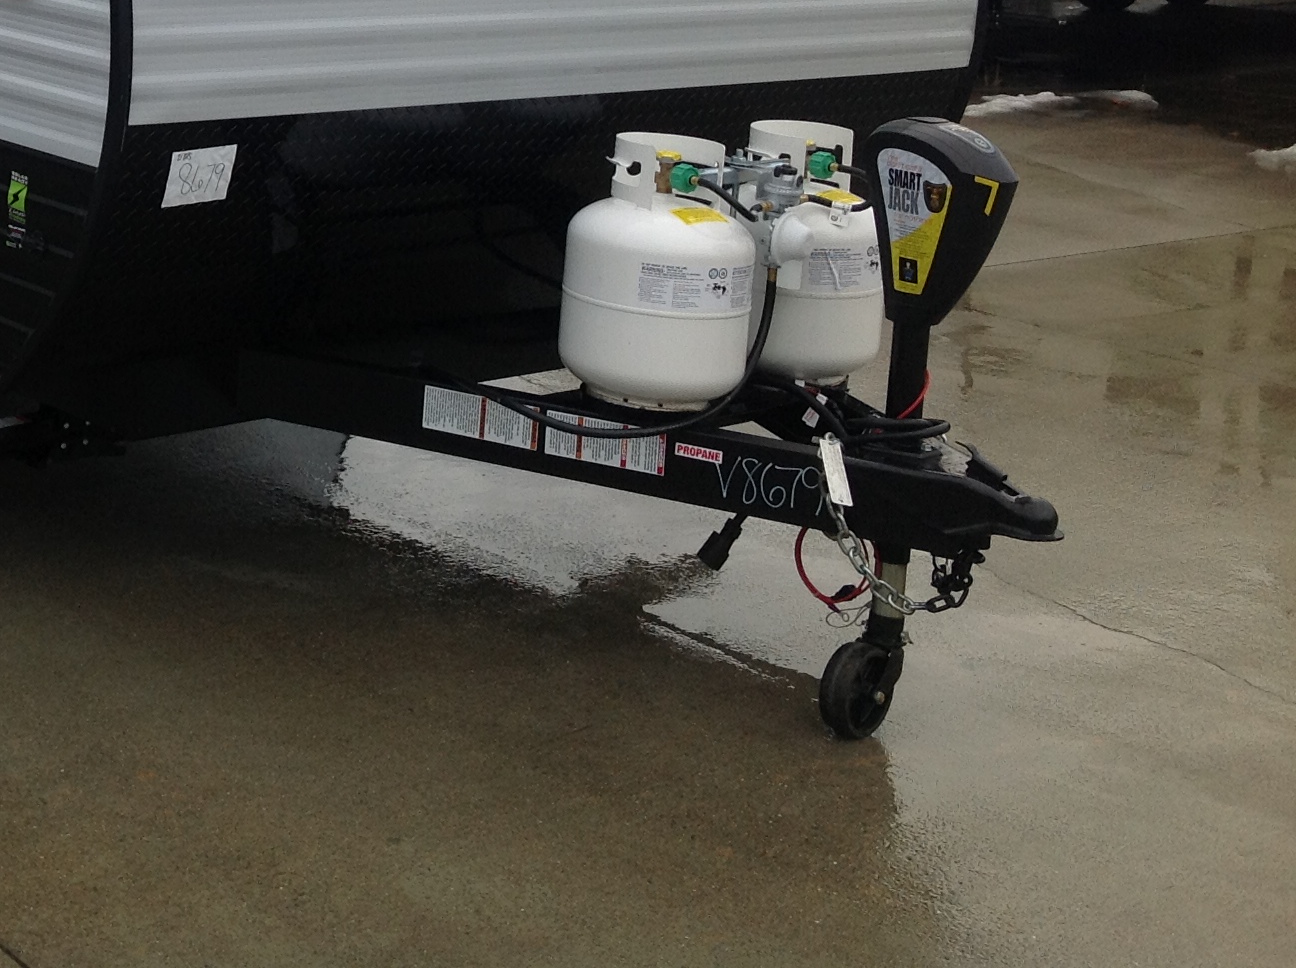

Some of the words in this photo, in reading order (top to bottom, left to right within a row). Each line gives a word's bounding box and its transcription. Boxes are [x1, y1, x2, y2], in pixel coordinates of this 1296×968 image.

[178, 162, 226, 195] 8679
[888, 168, 922, 192] SMART
[887, 186, 920, 215] JACK
[676, 444, 722, 463] PROPANE
[715, 455, 824, 517] V8679
